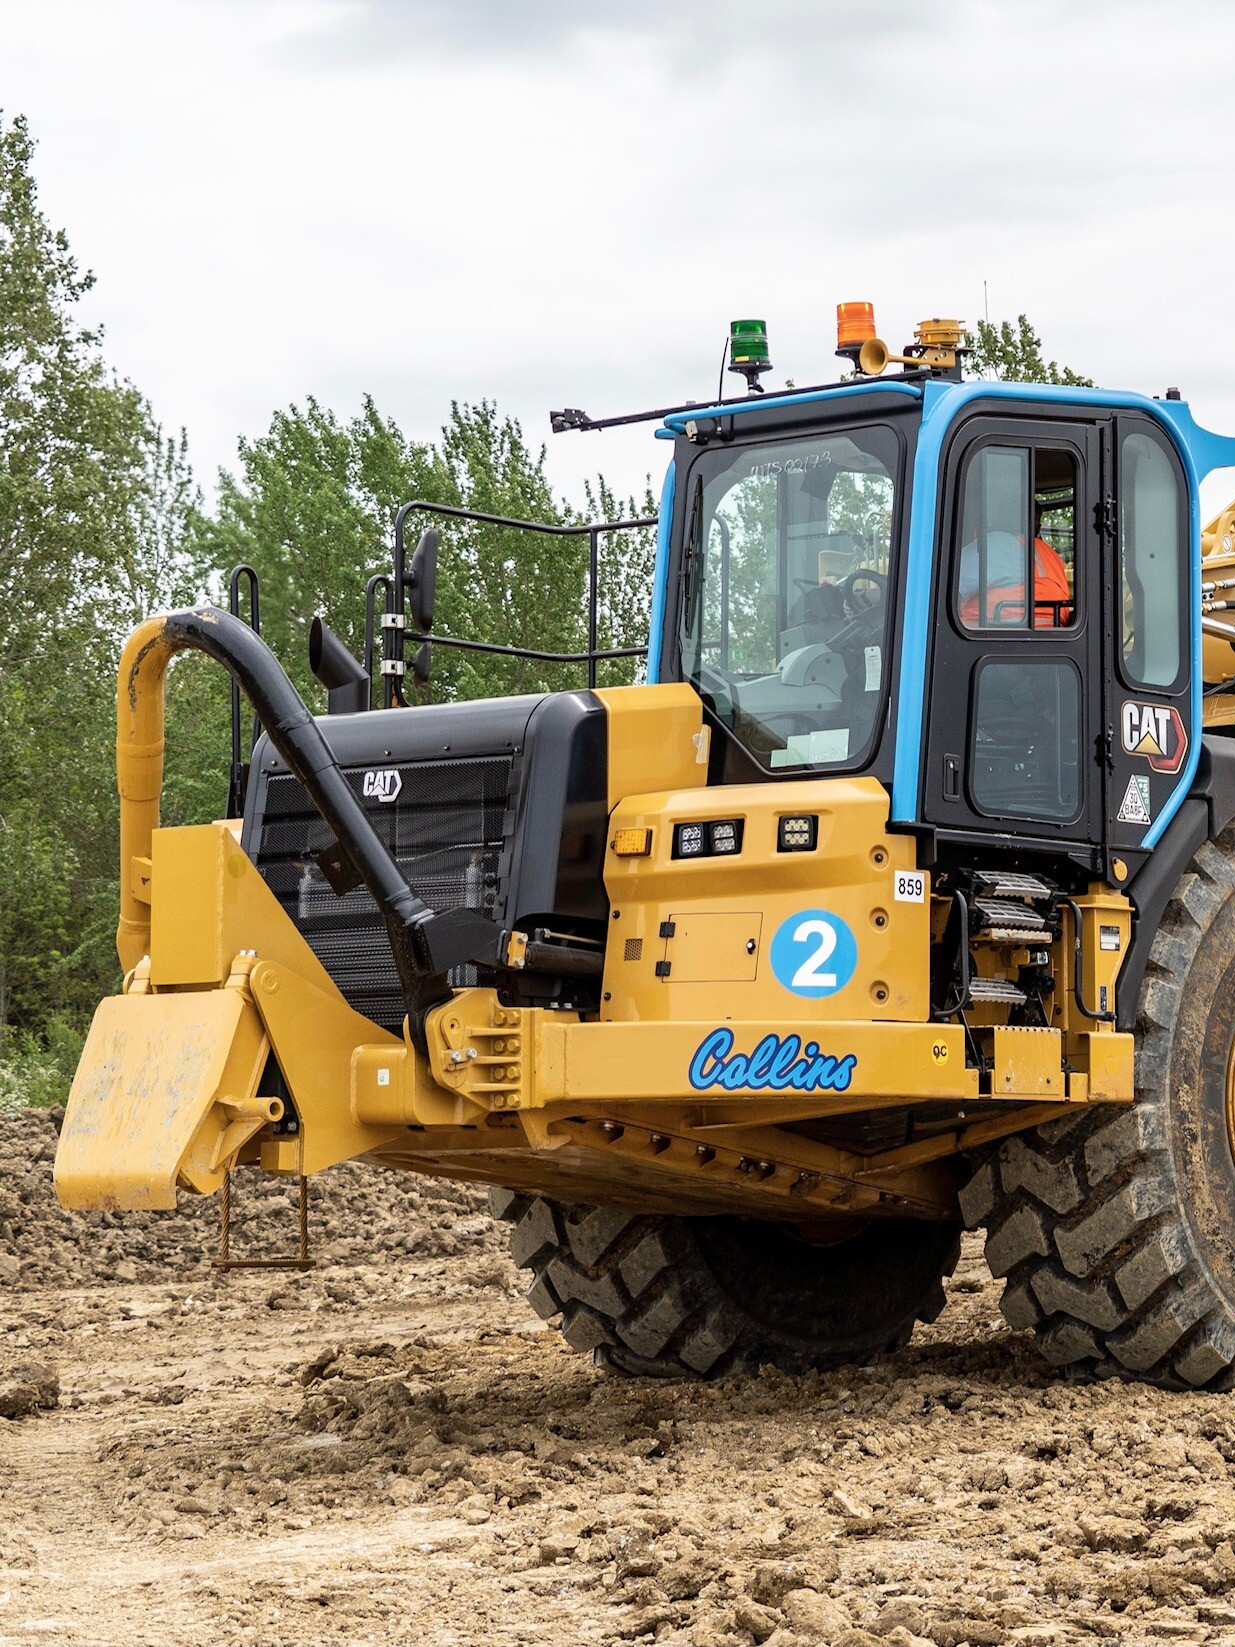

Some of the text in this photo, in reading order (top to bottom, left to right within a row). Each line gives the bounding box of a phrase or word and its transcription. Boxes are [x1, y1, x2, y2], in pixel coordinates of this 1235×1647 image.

[1123, 703, 1171, 755] CAT
[363, 770, 395, 797] CAT
[898, 878, 923, 896] 859
[791, 919, 837, 987] 2
[688, 1027, 857, 1091] Collins
[933, 1045, 947, 1059] QC
